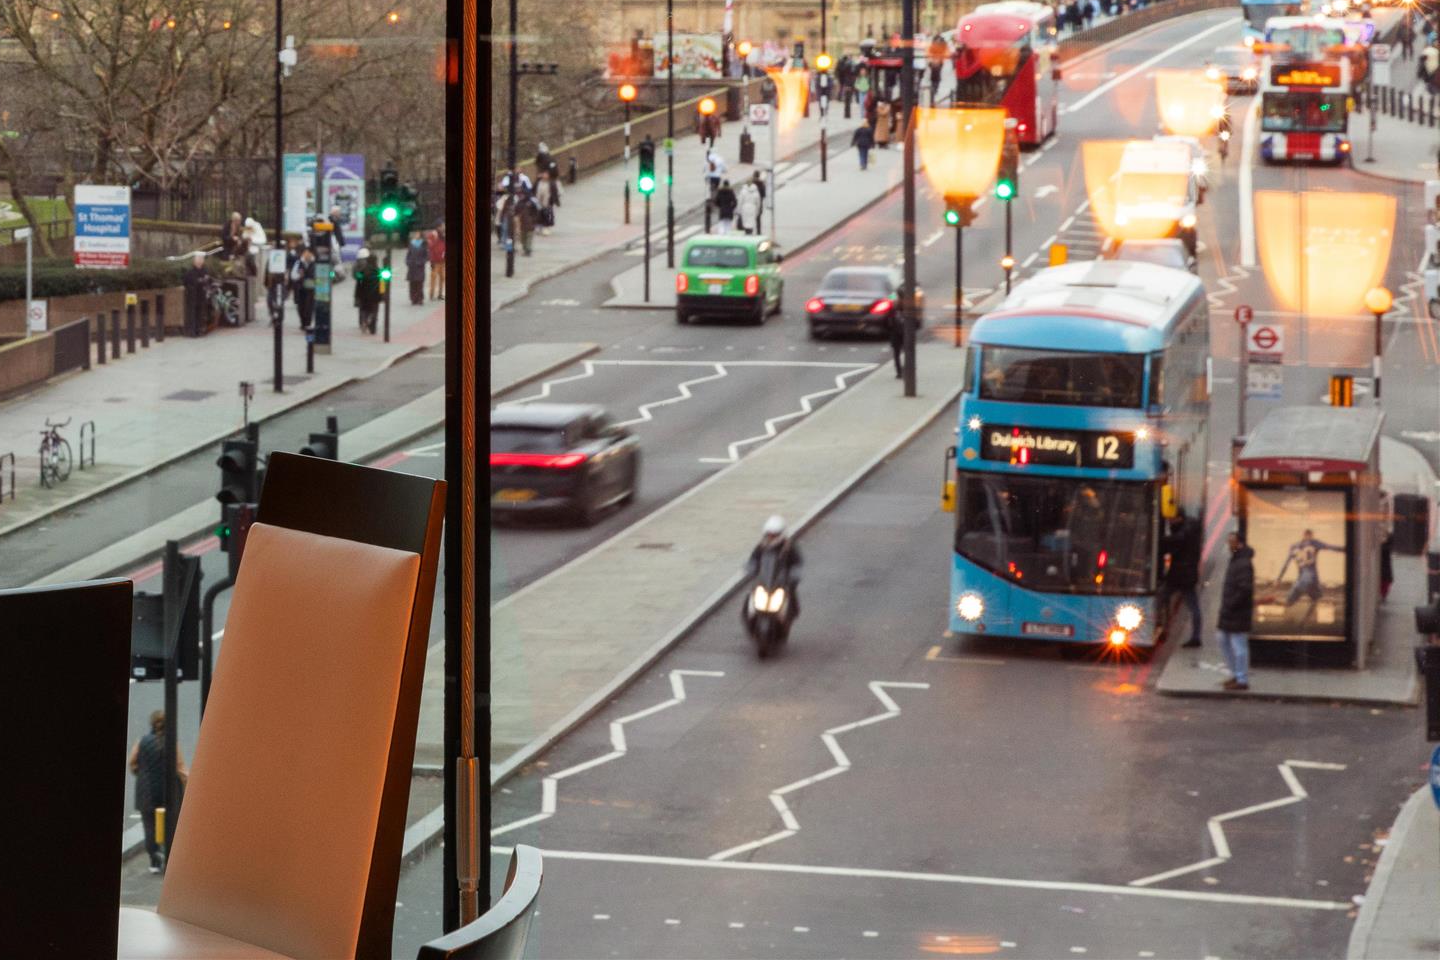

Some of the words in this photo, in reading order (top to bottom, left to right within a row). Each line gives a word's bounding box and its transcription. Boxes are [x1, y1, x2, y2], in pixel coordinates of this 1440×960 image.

[78, 212, 88, 223] St
[84, 224, 121, 236] Hospital
[1036, 435, 1077, 455] Library
[1096, 436, 1120, 460] 12
